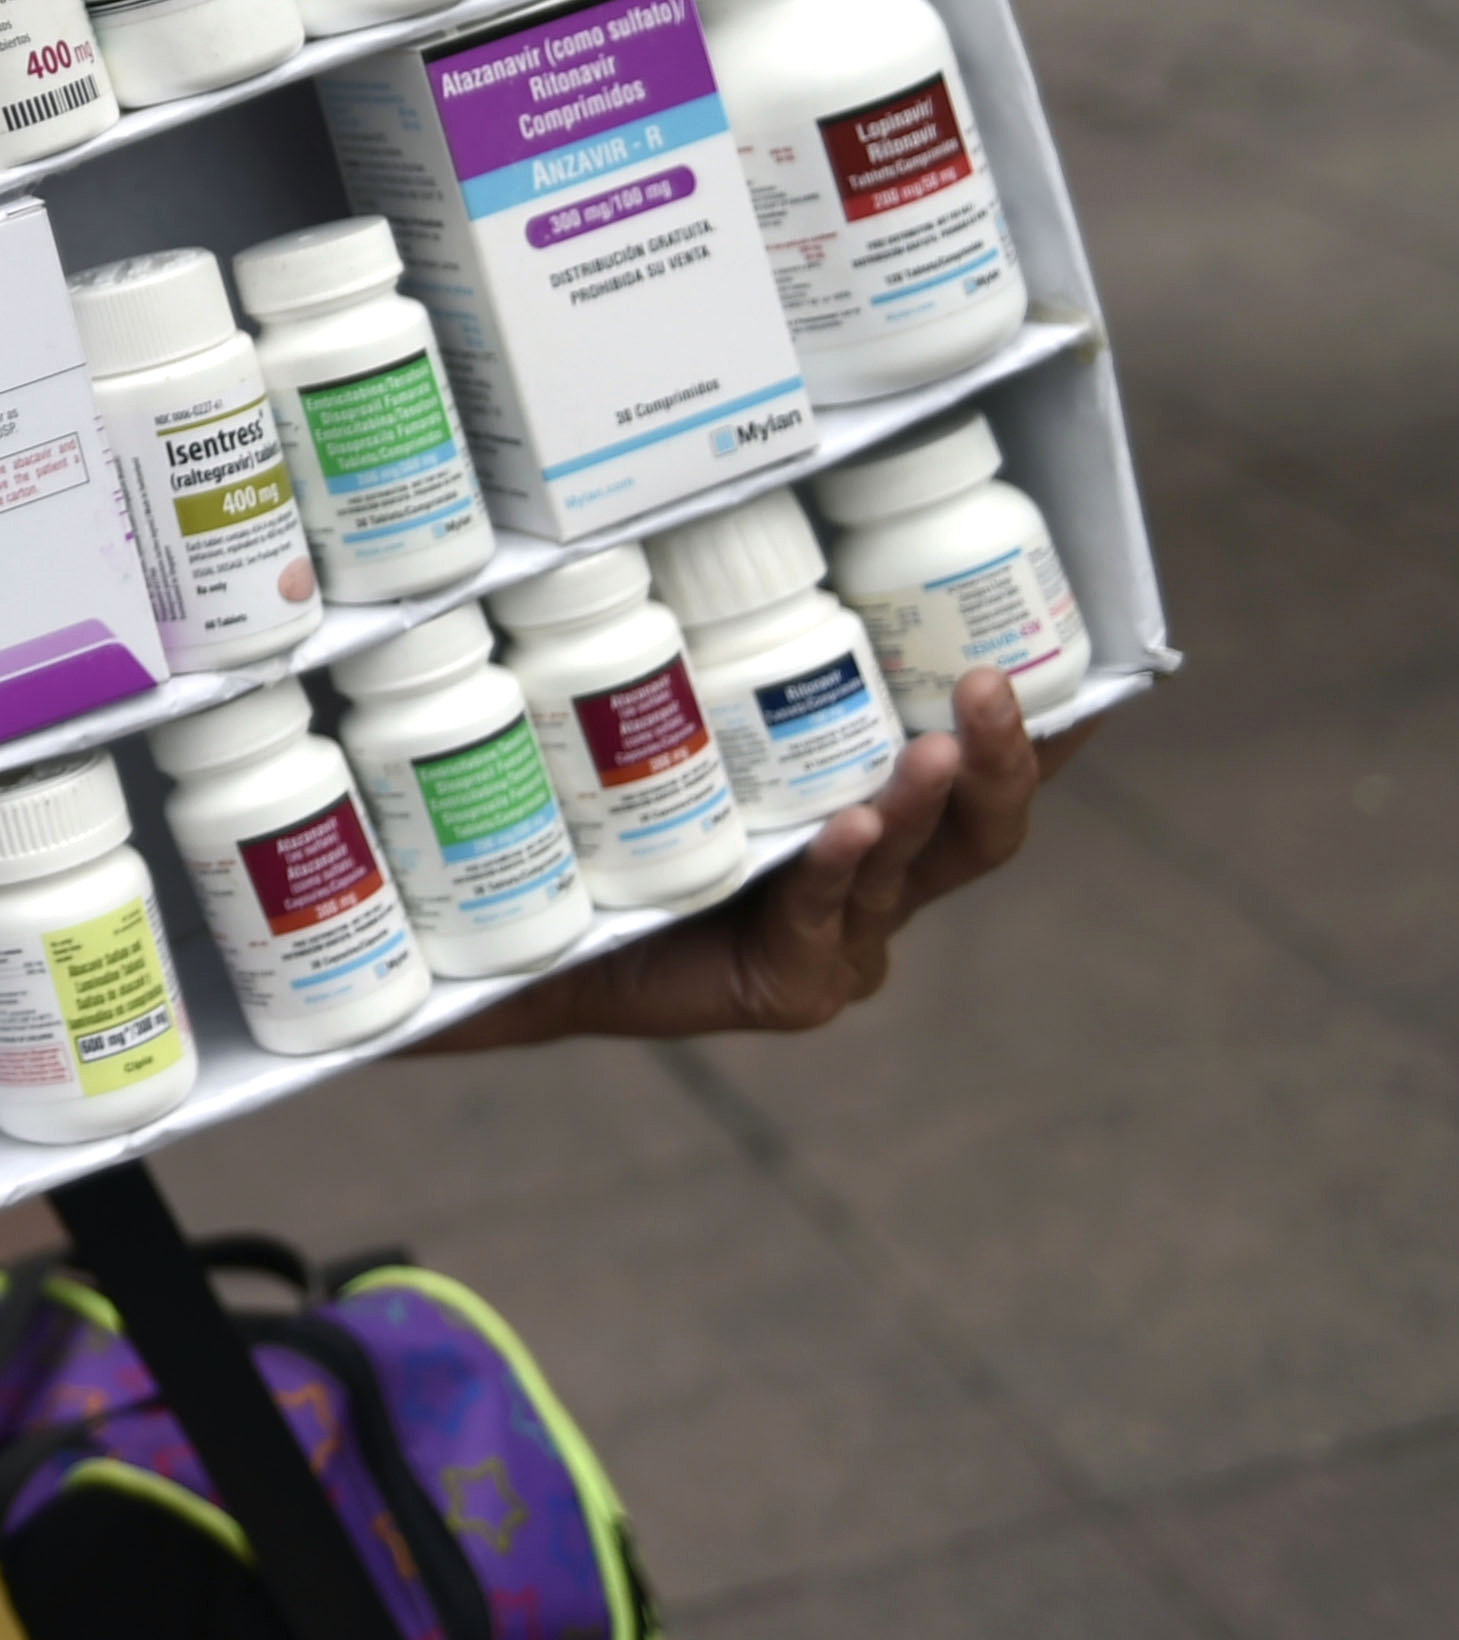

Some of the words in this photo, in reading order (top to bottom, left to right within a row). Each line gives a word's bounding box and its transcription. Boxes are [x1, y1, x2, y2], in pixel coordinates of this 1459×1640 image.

[27, 40, 72, 79] 400
[443, 49, 540, 97] Atazanavir
[545, 27, 604, 64] (como
[530, 57, 615, 100] Ritonavir
[519, 81, 645, 139] Comprimidos
[533, 138, 628, 190] ANZAVIR
[166, 420, 263, 467] Isentress
[737, 411, 801, 443] Mylan
[223, 486, 255, 514] 400
